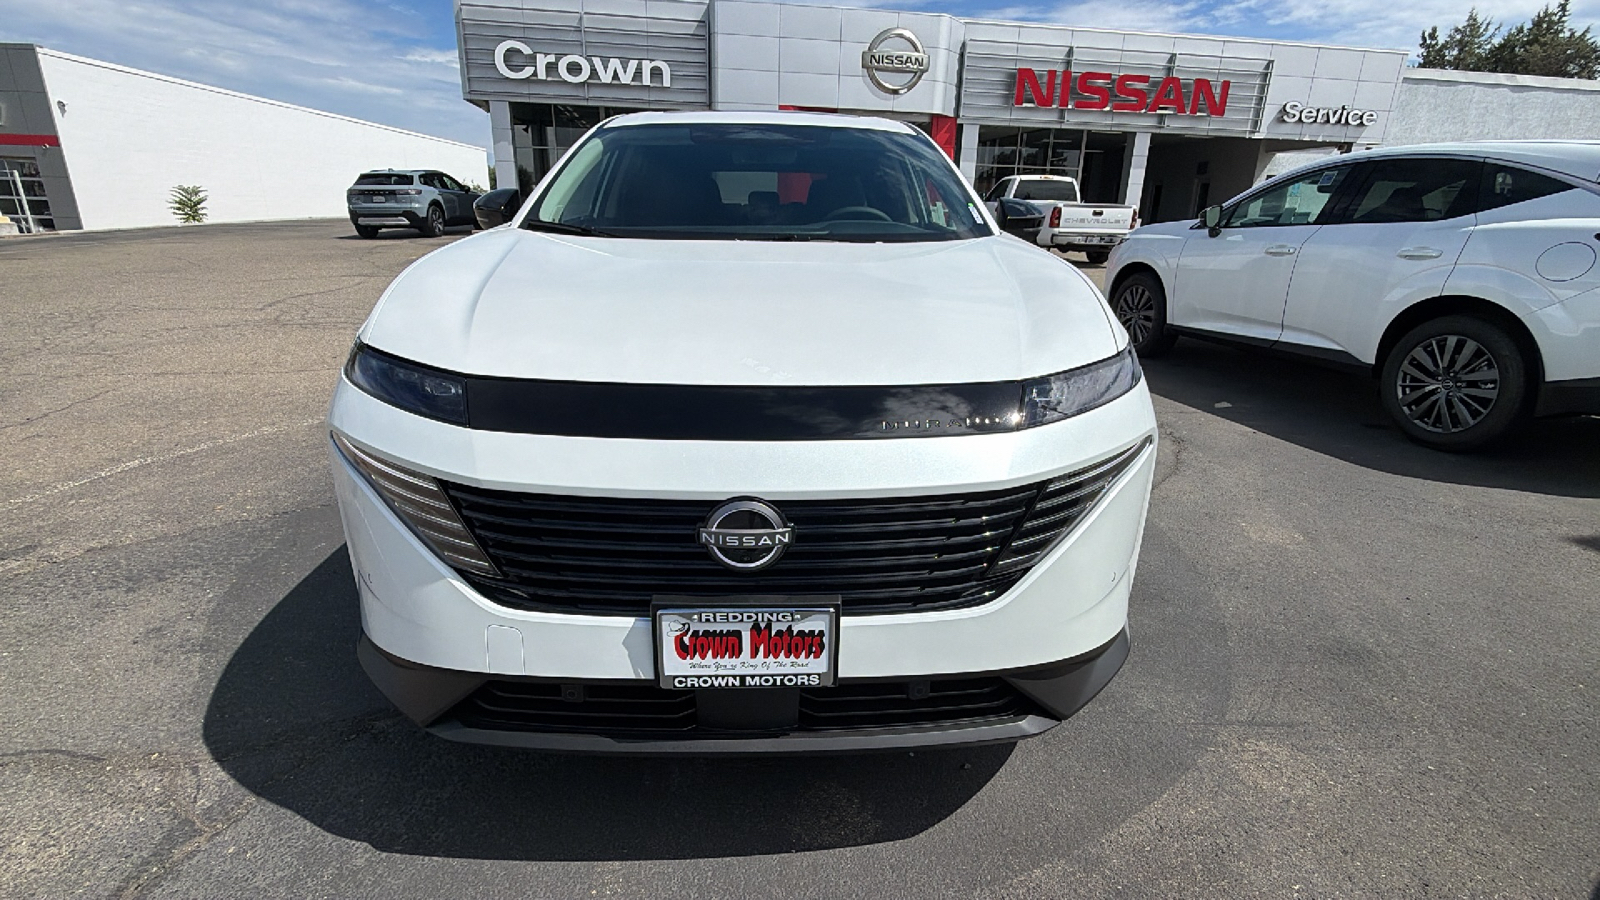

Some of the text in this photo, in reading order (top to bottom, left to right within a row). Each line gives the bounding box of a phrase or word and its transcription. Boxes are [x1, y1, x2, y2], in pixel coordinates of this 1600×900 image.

[494, 40, 671, 87] Crown
[868, 53, 925, 69] NISSAN
[1014, 67, 1231, 117] NISSAN
[1281, 101, 1379, 127] Service
[1064, 217, 1128, 225] CHEVROLET
[701, 531, 790, 547] NISSAN
[701, 612, 793, 623] REDDING
[674, 622, 826, 661] Crown Motors
[689, 661, 713, 670] Where
[739, 661, 759, 671] King
[760, 661, 771, 670] Of
[774, 660, 788, 668] The
[789, 660, 810, 669] Road
[673, 674, 820, 688] CROWN MOTORS
